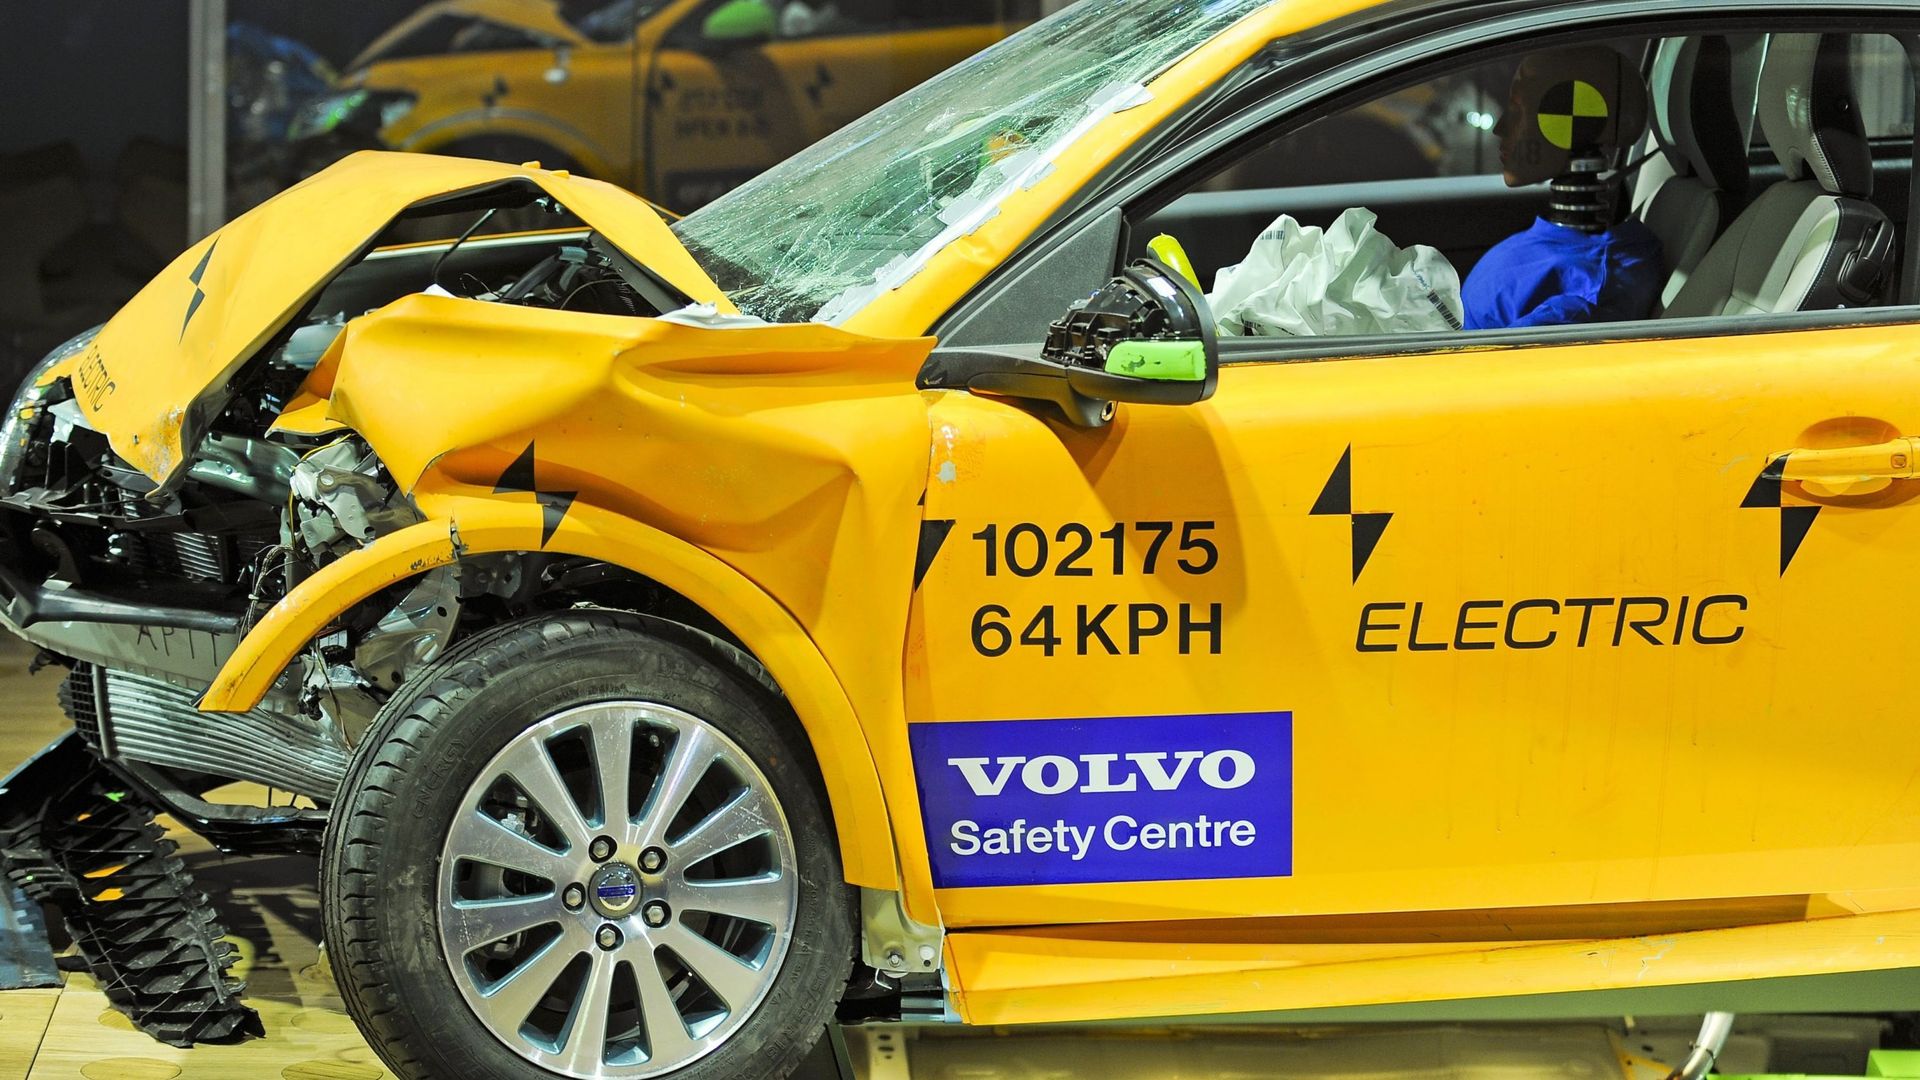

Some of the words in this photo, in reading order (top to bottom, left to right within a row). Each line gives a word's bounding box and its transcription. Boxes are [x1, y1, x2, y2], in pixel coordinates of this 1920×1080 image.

[79, 344, 116, 412] ELECTRIC
[972, 520, 1219, 577] 102175
[971, 604, 1062, 657] 64
[1077, 603, 1222, 656] KPH
[1356, 594, 1748, 653] ELECTRIC
[948, 749, 1256, 796] VOLVO
[950, 818, 1096, 861] Safety
[1103, 815, 1256, 850] Centre
